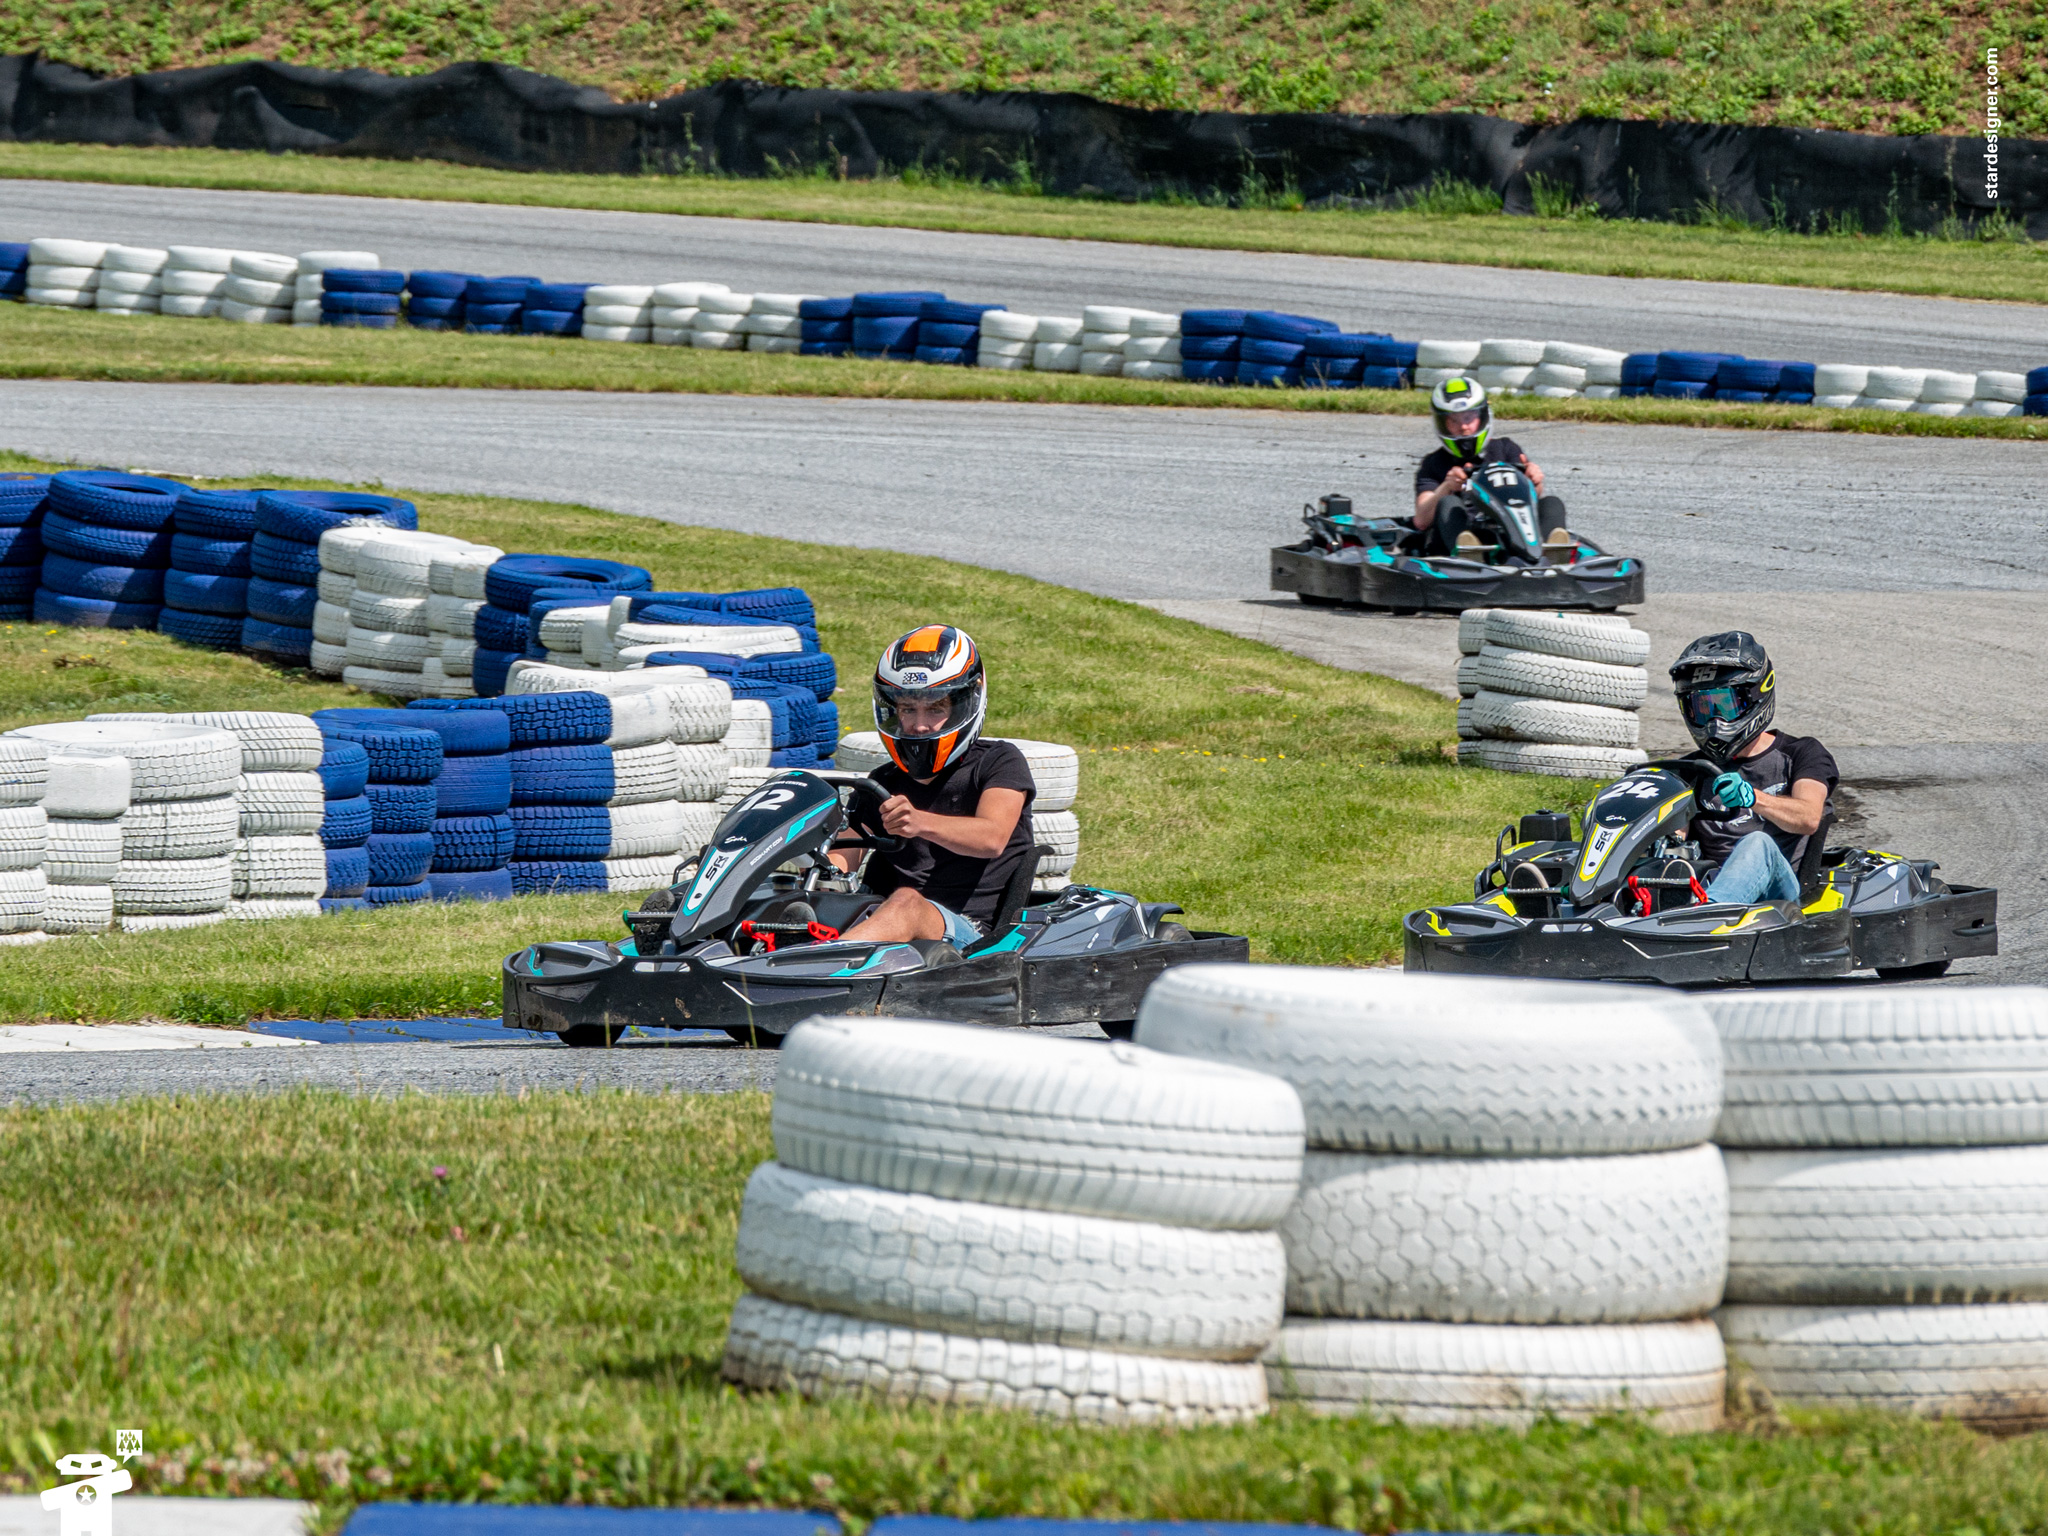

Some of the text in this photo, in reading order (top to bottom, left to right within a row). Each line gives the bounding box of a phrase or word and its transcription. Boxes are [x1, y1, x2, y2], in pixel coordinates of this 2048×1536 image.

[1487, 472, 1518, 487] 11
[1691, 666, 1718, 684] 95
[737, 788, 795, 813] 12
[1599, 781, 1660, 801] 24
